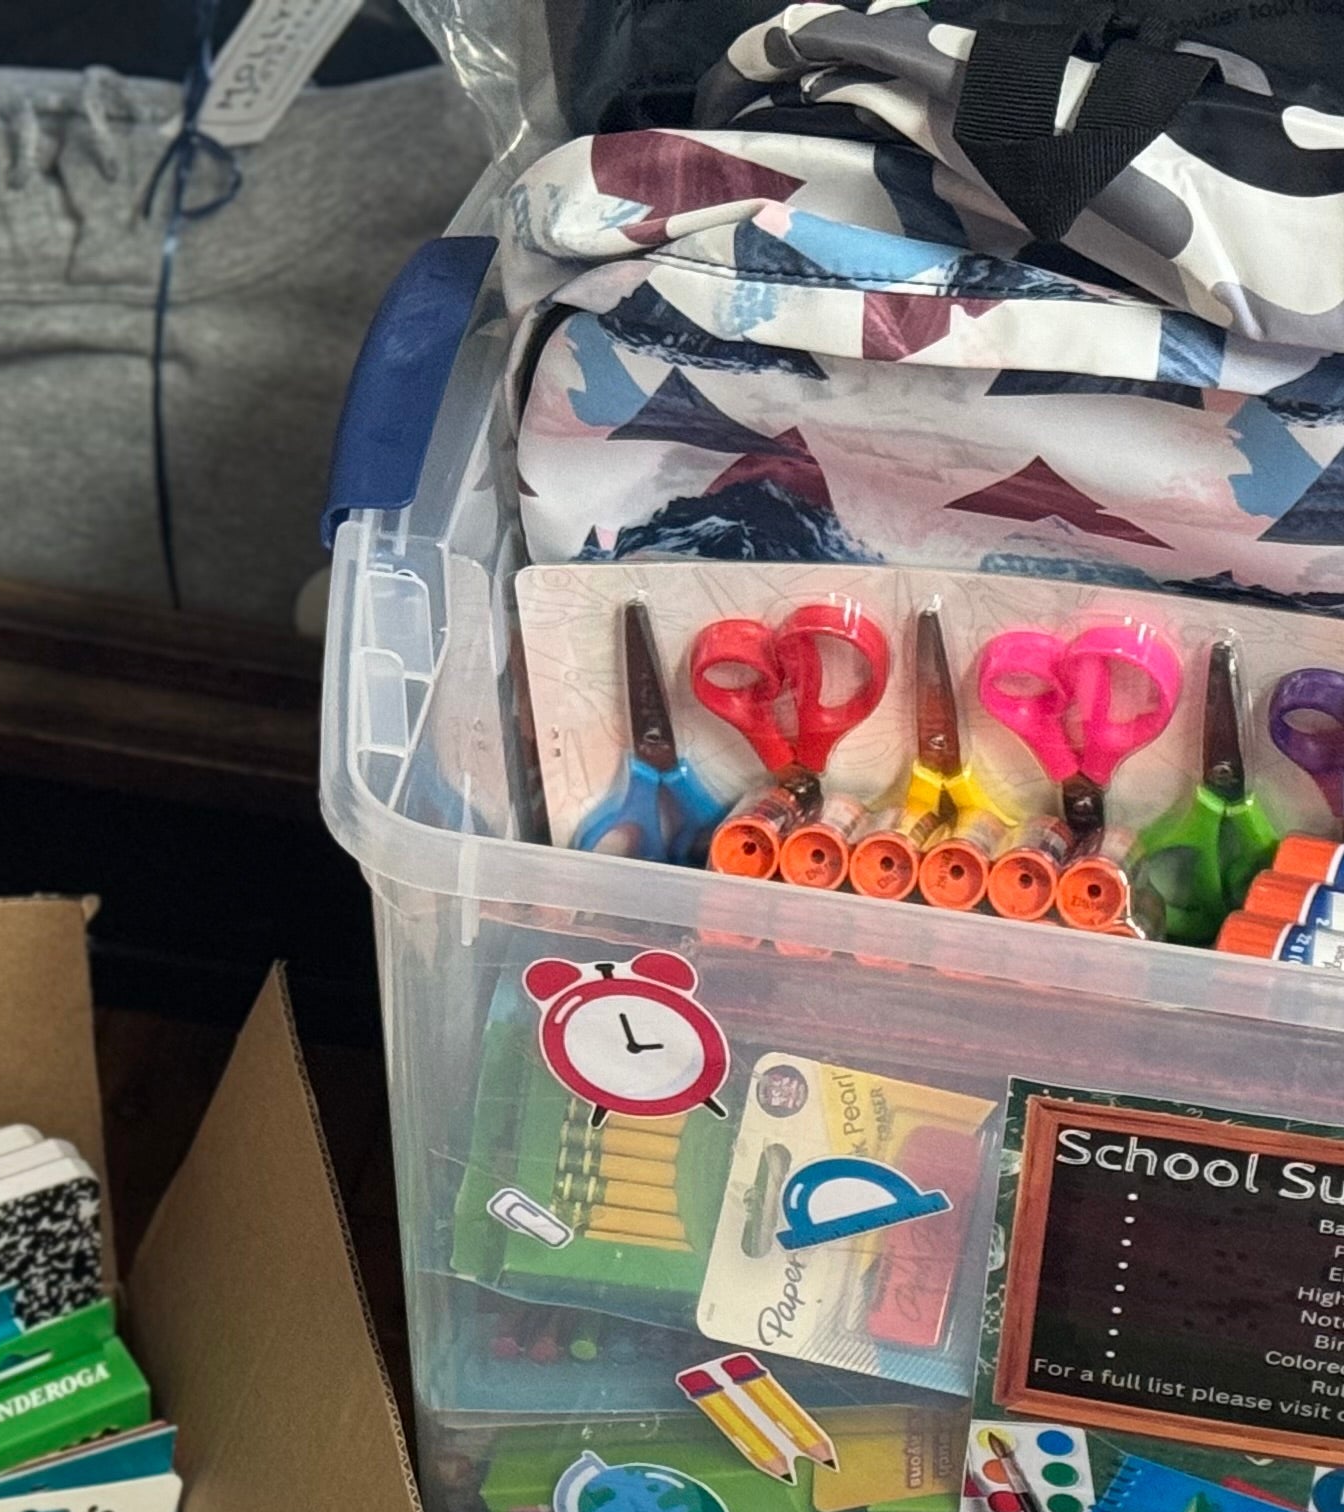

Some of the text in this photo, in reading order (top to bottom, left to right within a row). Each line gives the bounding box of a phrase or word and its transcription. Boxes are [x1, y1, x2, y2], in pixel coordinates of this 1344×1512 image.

[831, 1072, 864, 1137] Pearl
[1056, 1128, 1259, 1193] School
[757, 1250, 808, 1347] Paper
[1033, 1358, 1075, 1379] For
[1080, 1367, 1094, 1383] a
[1101, 1369, 1142, 1391] full
[1147, 1376, 1186, 1398] list
[1191, 1388, 1273, 1412] please
[1279, 1397, 1332, 1421] visit
